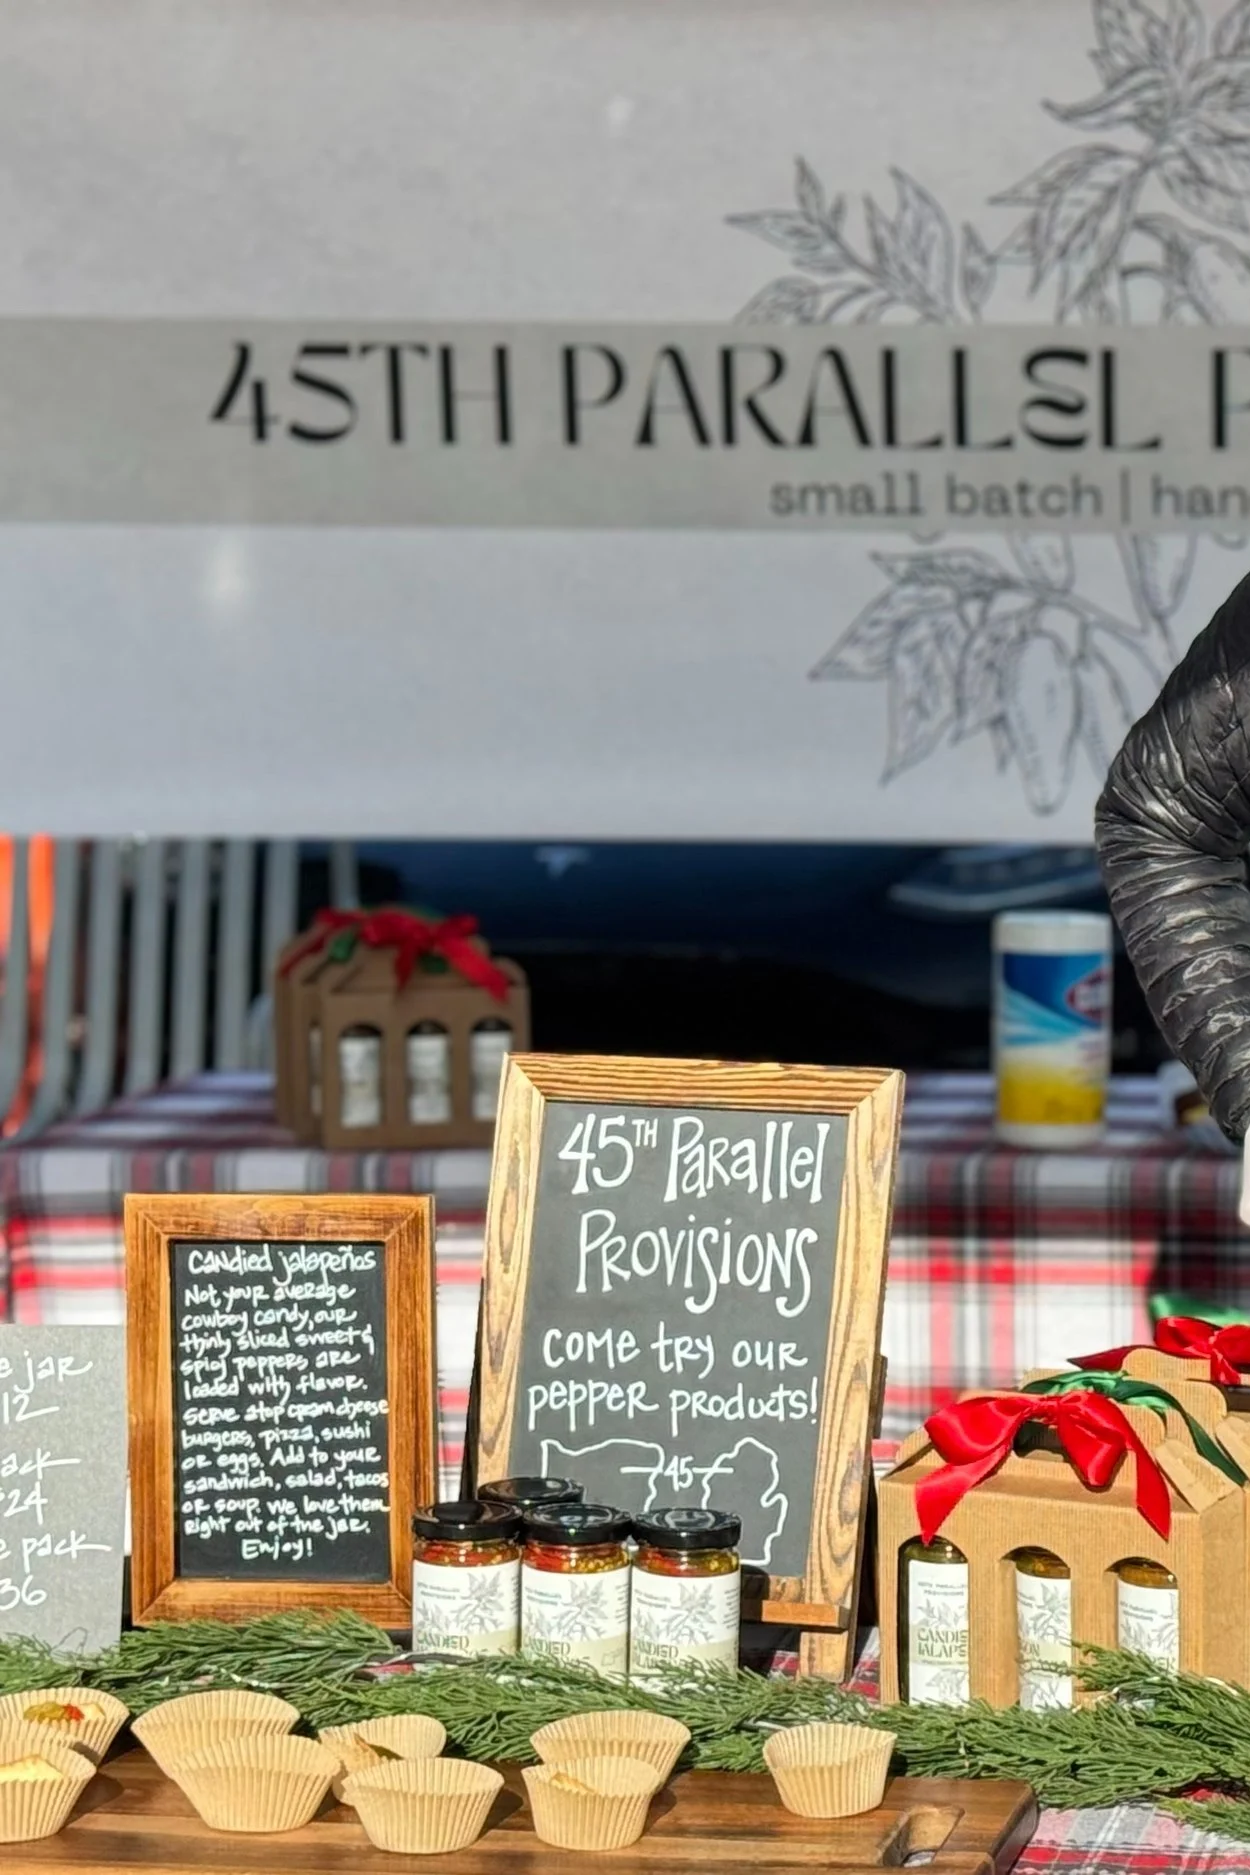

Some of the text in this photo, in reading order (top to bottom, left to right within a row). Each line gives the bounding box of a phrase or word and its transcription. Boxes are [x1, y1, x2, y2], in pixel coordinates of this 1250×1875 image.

[208, 340, 512, 446] 45TH
[562, 341, 1160, 452] PARALLEL
[769, 472, 925, 518] small
[946, 473, 1101, 519] batch
[188, 1243, 274, 1275] Candied
[273, 1282, 356, 1306] average
[181, 1310, 248, 1337] cowboy
[237, 1326, 290, 1350] sliced
[13, 1350, 94, 1394] jar
[232, 1353, 308, 1381] peppers
[184, 1375, 239, 1400] loaded
[669, 1376, 819, 1437] products!
[321, 1421, 371, 1441] sushi
[0, 1447, 82, 1480] ack
[269, 1444, 305, 1466] Add
[309, 1446, 329, 1467] to
[333, 1446, 381, 1471] your
[183, 1470, 282, 1494] sandwich,
[343, 1470, 389, 1489] tacos
[664, 1456, 694, 1491] 45
[304, 1495, 340, 1514] love
[339, 1493, 391, 1515] them
[235, 1516, 263, 1532] out
[266, 1515, 289, 1536] of
[22, 1529, 112, 1574] pack
[242, 1535, 313, 1560] Enjoy!
[917, 1628, 969, 1644] CANDIE
